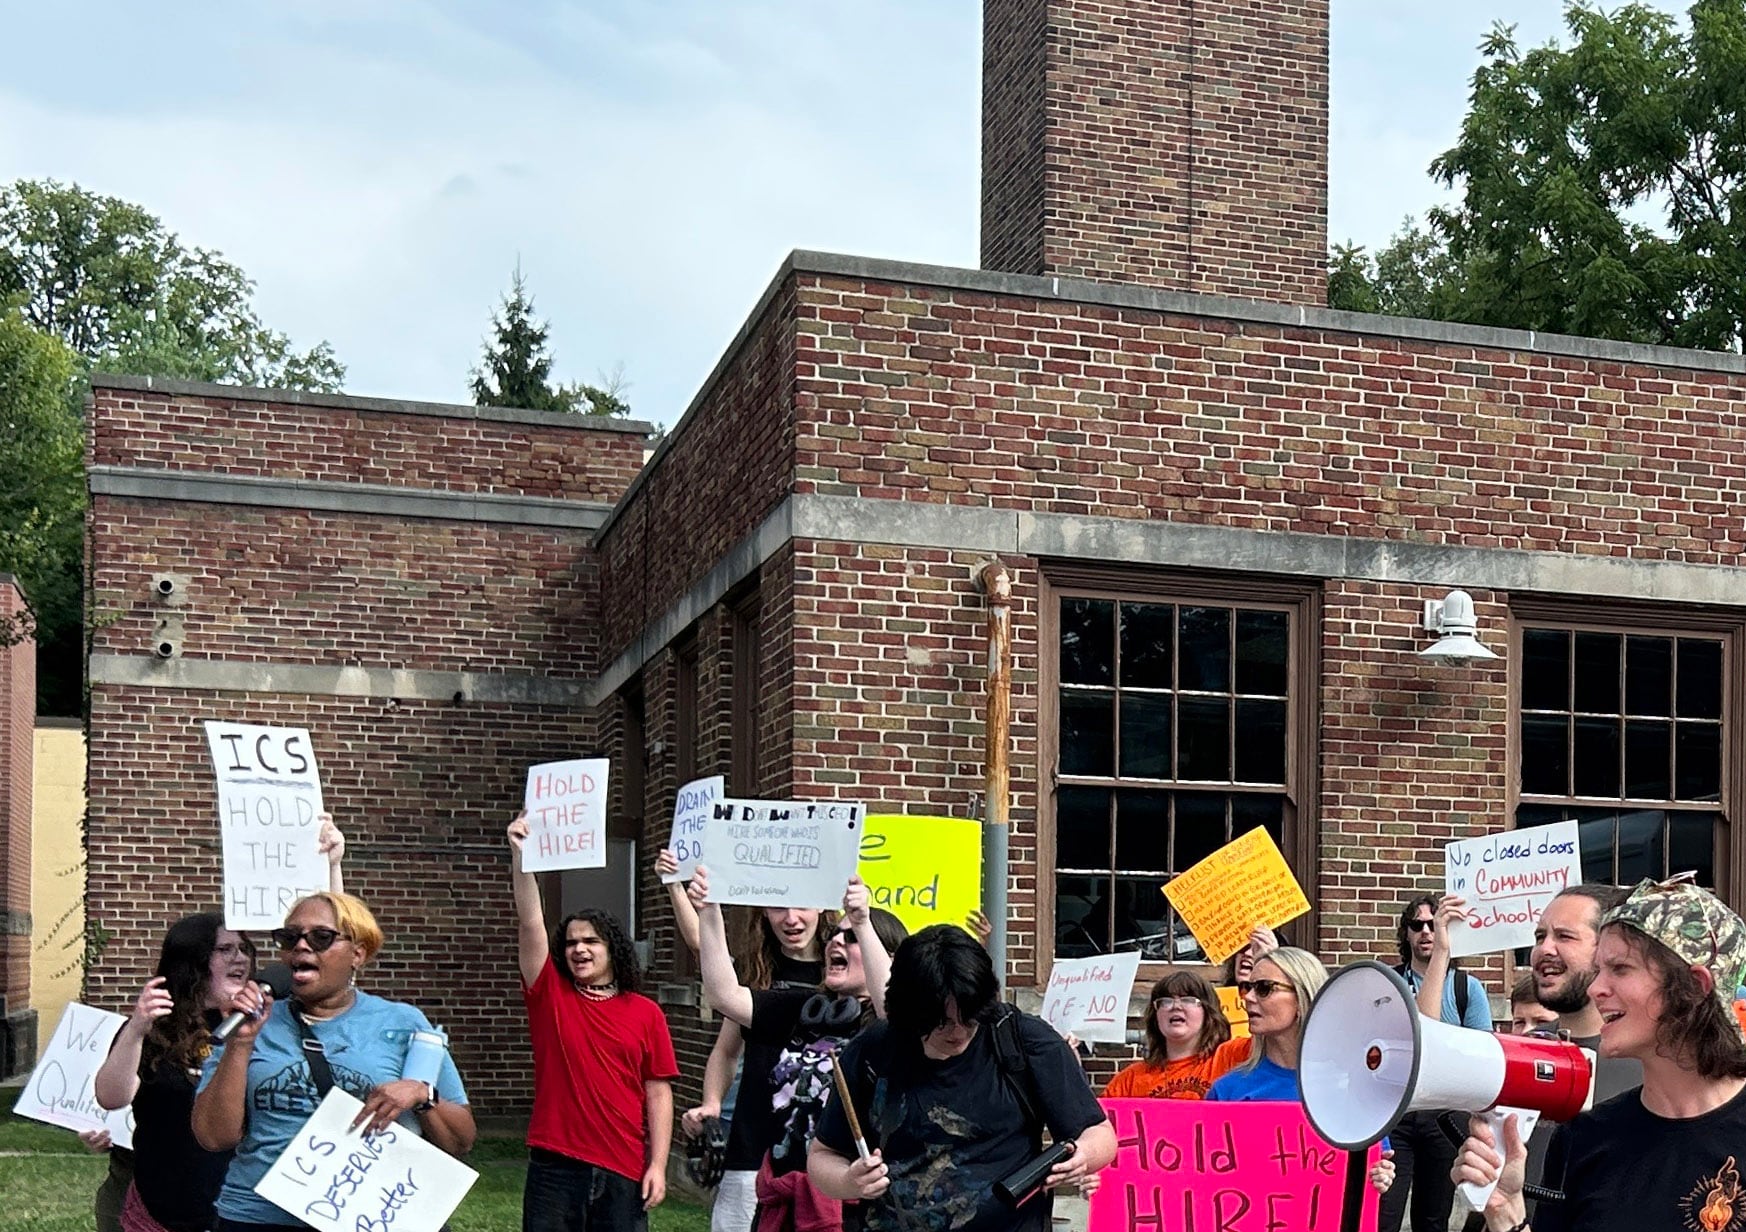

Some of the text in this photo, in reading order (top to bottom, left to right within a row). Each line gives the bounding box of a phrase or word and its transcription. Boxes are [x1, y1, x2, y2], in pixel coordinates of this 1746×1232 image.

[221, 734, 308, 774] ICS
[536, 773, 595, 800] HOLD
[678, 786, 714, 815] DRAIN
[229, 797, 313, 827] HOLD
[536, 803, 588, 828] THE
[680, 815, 707, 834] THE
[243, 842, 297, 871] THE
[539, 830, 595, 859] HIRE!
[734, 843, 821, 867] QUALIFIED
[1450, 832, 1575, 868] No closed doors
[1452, 866, 1570, 895] in COMMUNITY
[1051, 964, 1114, 991] Unqualified
[67, 1008, 108, 1052] We
[1108, 1109, 1338, 1176] Hold the
[281, 1135, 336, 1187] ICS
[306, 1128, 397, 1222] DESERVES
